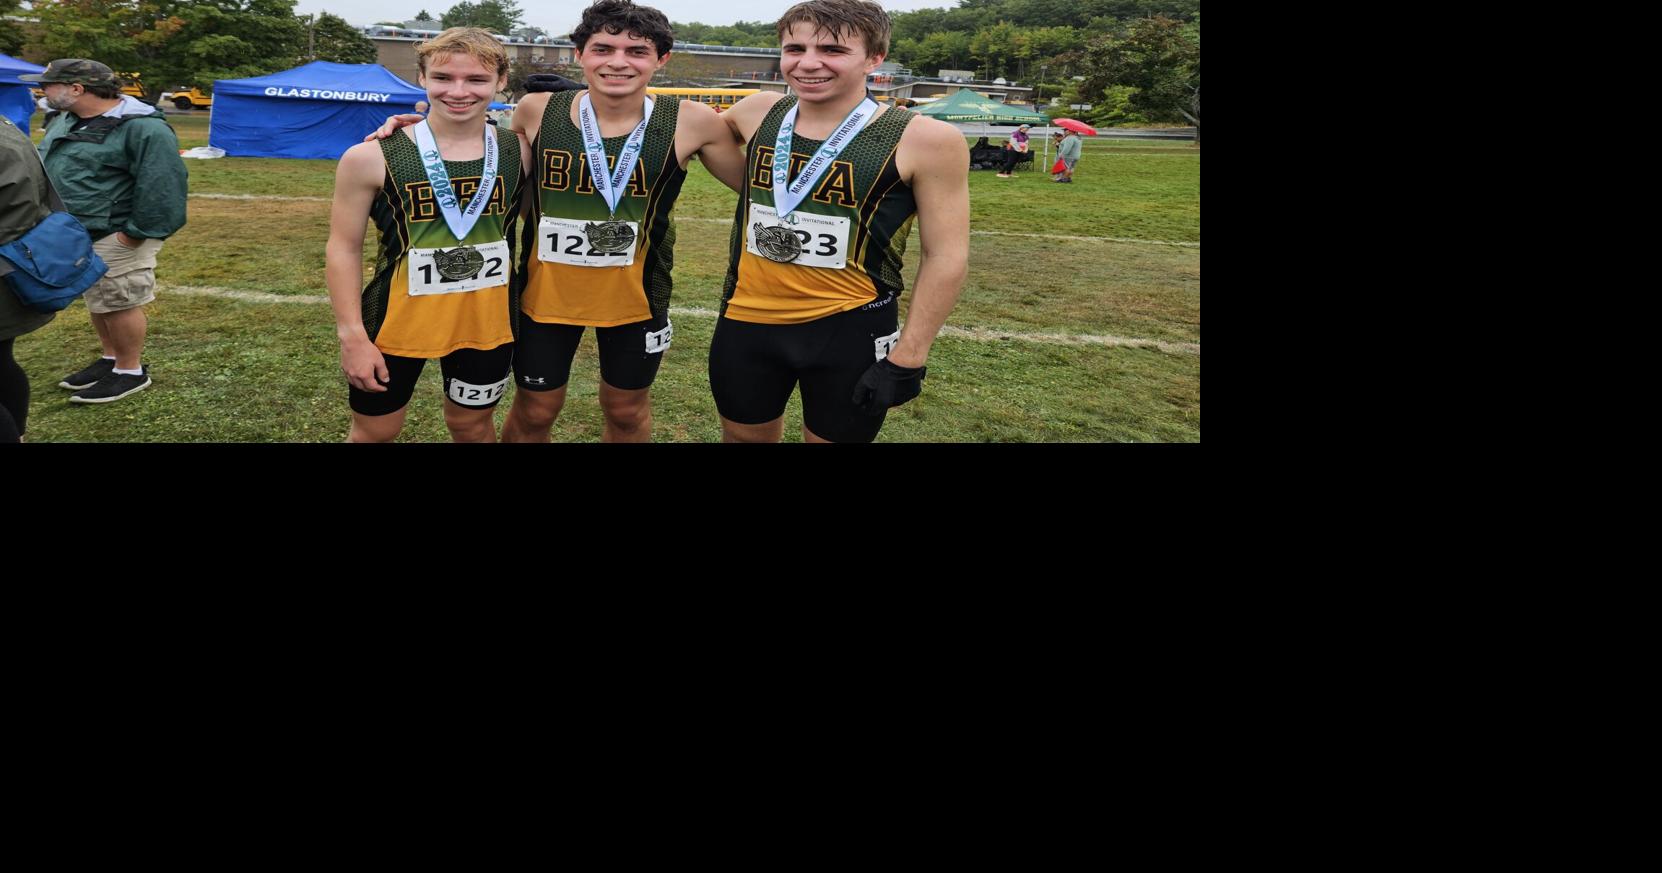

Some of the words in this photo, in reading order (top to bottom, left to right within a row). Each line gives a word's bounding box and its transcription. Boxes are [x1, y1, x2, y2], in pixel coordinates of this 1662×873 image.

[264, 86, 391, 103] GLASTONBURY
[581, 107, 595, 143] INVITATIONAL
[612, 152, 632, 189] MANCHESTER
[775, 134, 790, 172] 2024
[791, 156, 825, 195] MANCHESTER
[828, 112, 864, 148] INVITATIONAL
[426, 162, 453, 198] 2024
[591, 153, 606, 191] MANCHESTER
[467, 178, 490, 216] MANCHESTER
[546, 232, 628, 257] 12
[417, 256, 503, 285] 12
[457, 383, 505, 401] 1212
